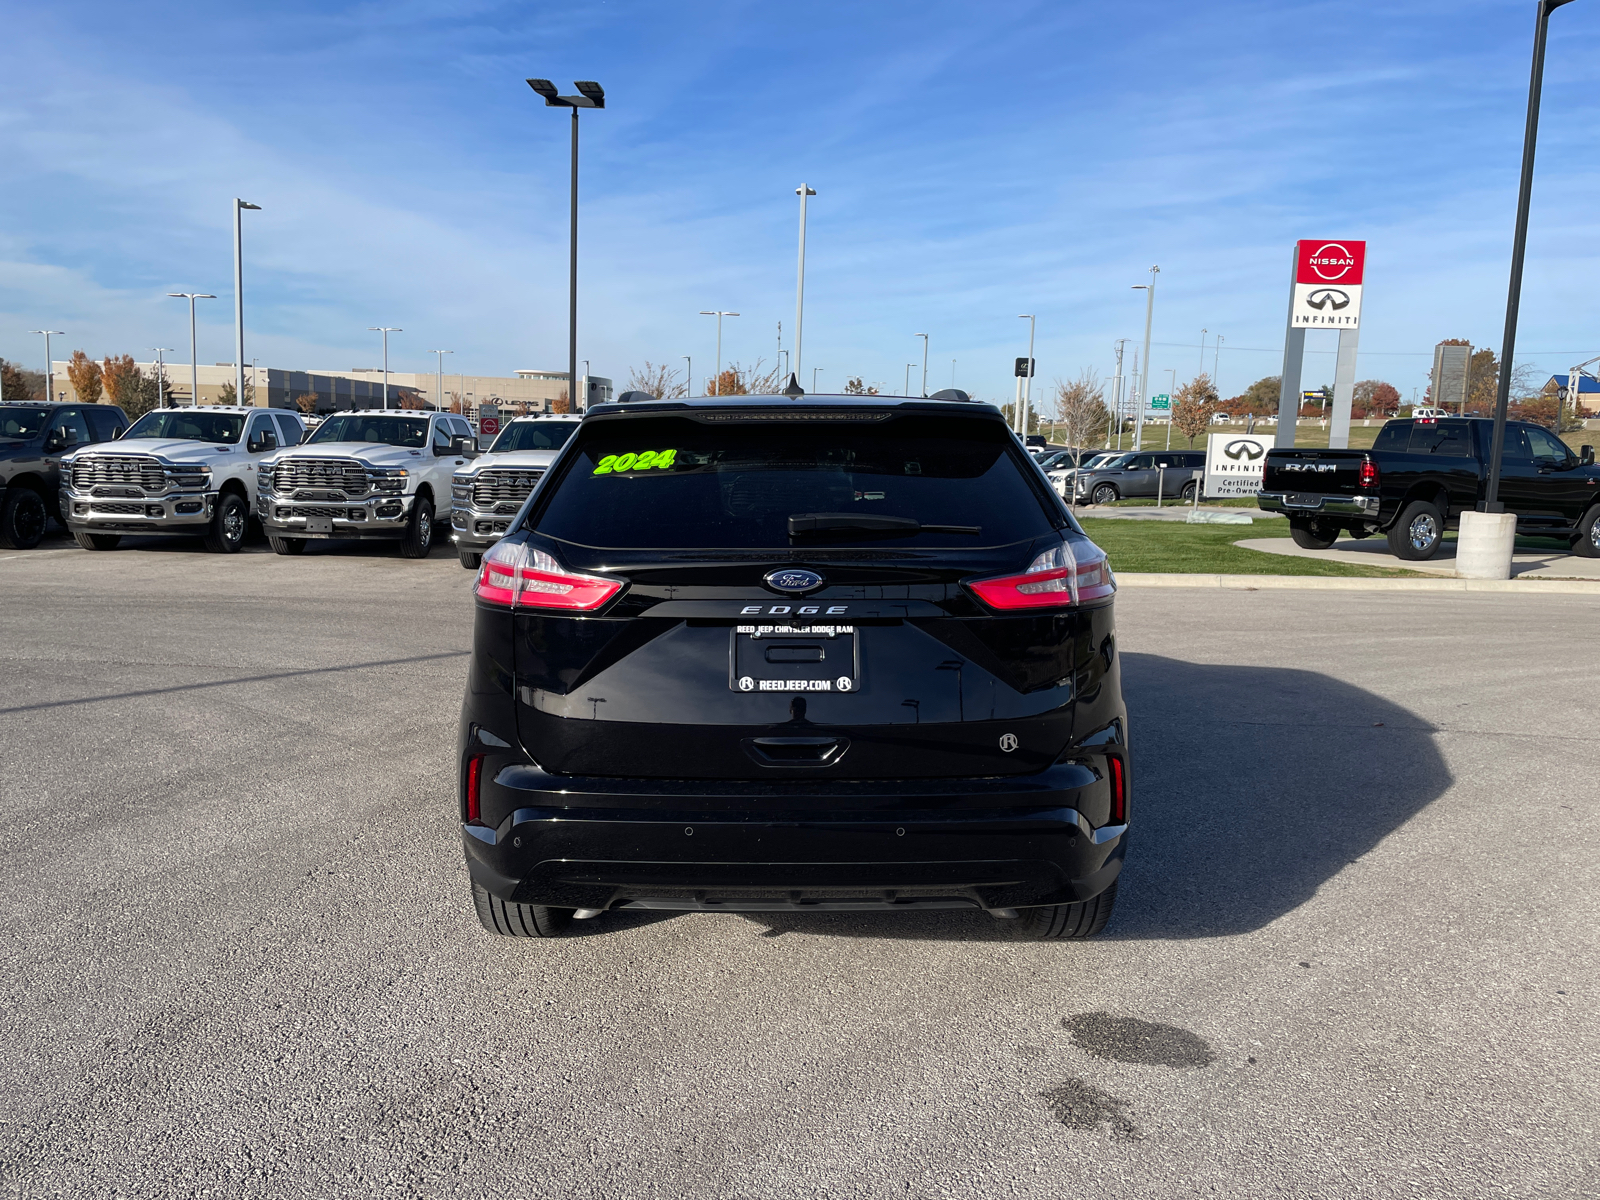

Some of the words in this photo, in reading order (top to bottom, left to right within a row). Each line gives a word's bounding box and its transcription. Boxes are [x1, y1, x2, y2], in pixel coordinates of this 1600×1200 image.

[1296, 315, 1357, 324] INFINITI
[93, 462, 139, 472] RAM
[593, 449, 677, 475] 2024
[296, 466, 342, 475] RAM
[1216, 464, 1263, 472] INFINIT
[1285, 463, 1337, 473] RAM
[1222, 479, 1259, 487] Certified
[780, 573, 810, 588] Ford
[740, 605, 849, 615] EDGE
[737, 625, 756, 633] REED
[757, 625, 774, 633] JEEP
[811, 625, 836, 633] DODGE
[836, 625, 854, 633] RAM
[759, 680, 831, 691] REEDJEEP.COM
[1000, 733, 1020, 752] R
